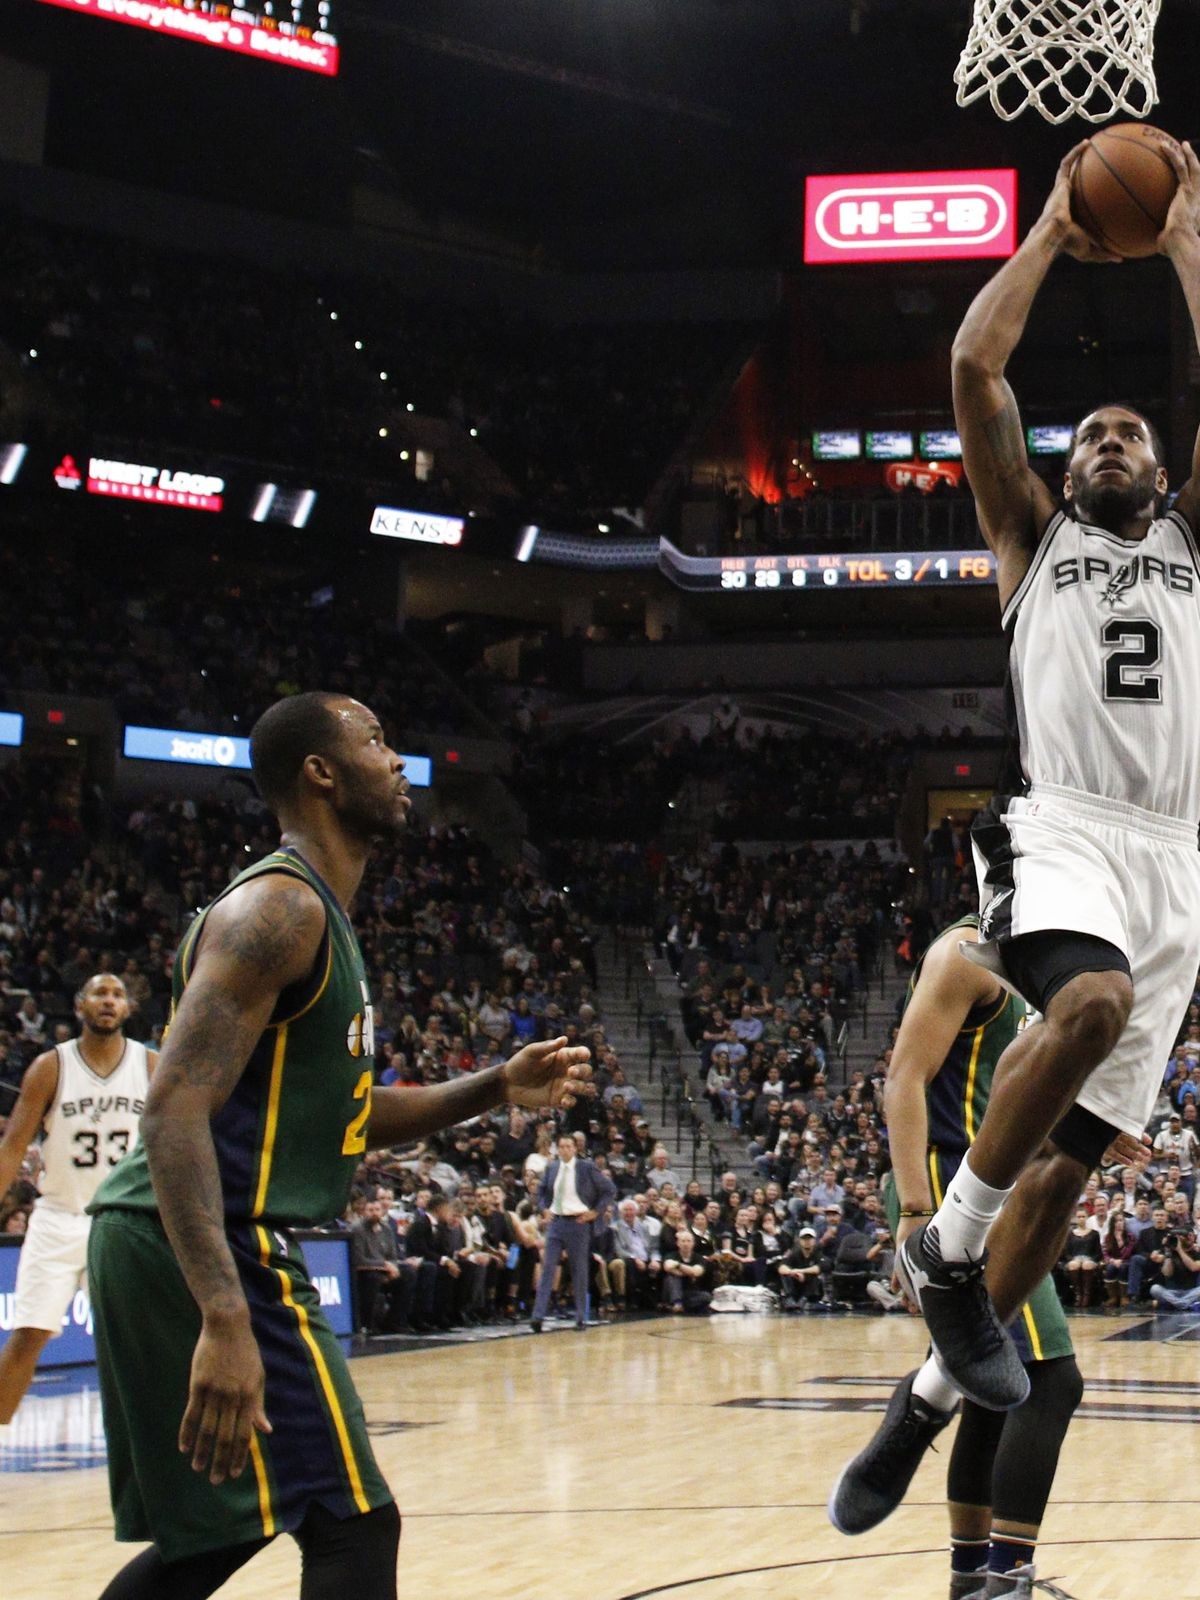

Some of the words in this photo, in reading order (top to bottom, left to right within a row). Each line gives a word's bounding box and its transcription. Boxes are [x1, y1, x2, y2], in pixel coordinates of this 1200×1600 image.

[839, 198, 988, 235] H-E-B
[88, 457, 159, 488] WEST
[158, 469, 225, 497] LOOP
[721, 571, 747, 589] 30
[823, 568, 839, 586] 0
[846, 561, 888, 581] TOL
[959, 557, 991, 578] FG
[1053, 554, 1195, 602] SPURS
[1102, 616, 1162, 702] 2
[61, 1096, 145, 1118] SPURS
[73, 1130, 130, 1168] 33
